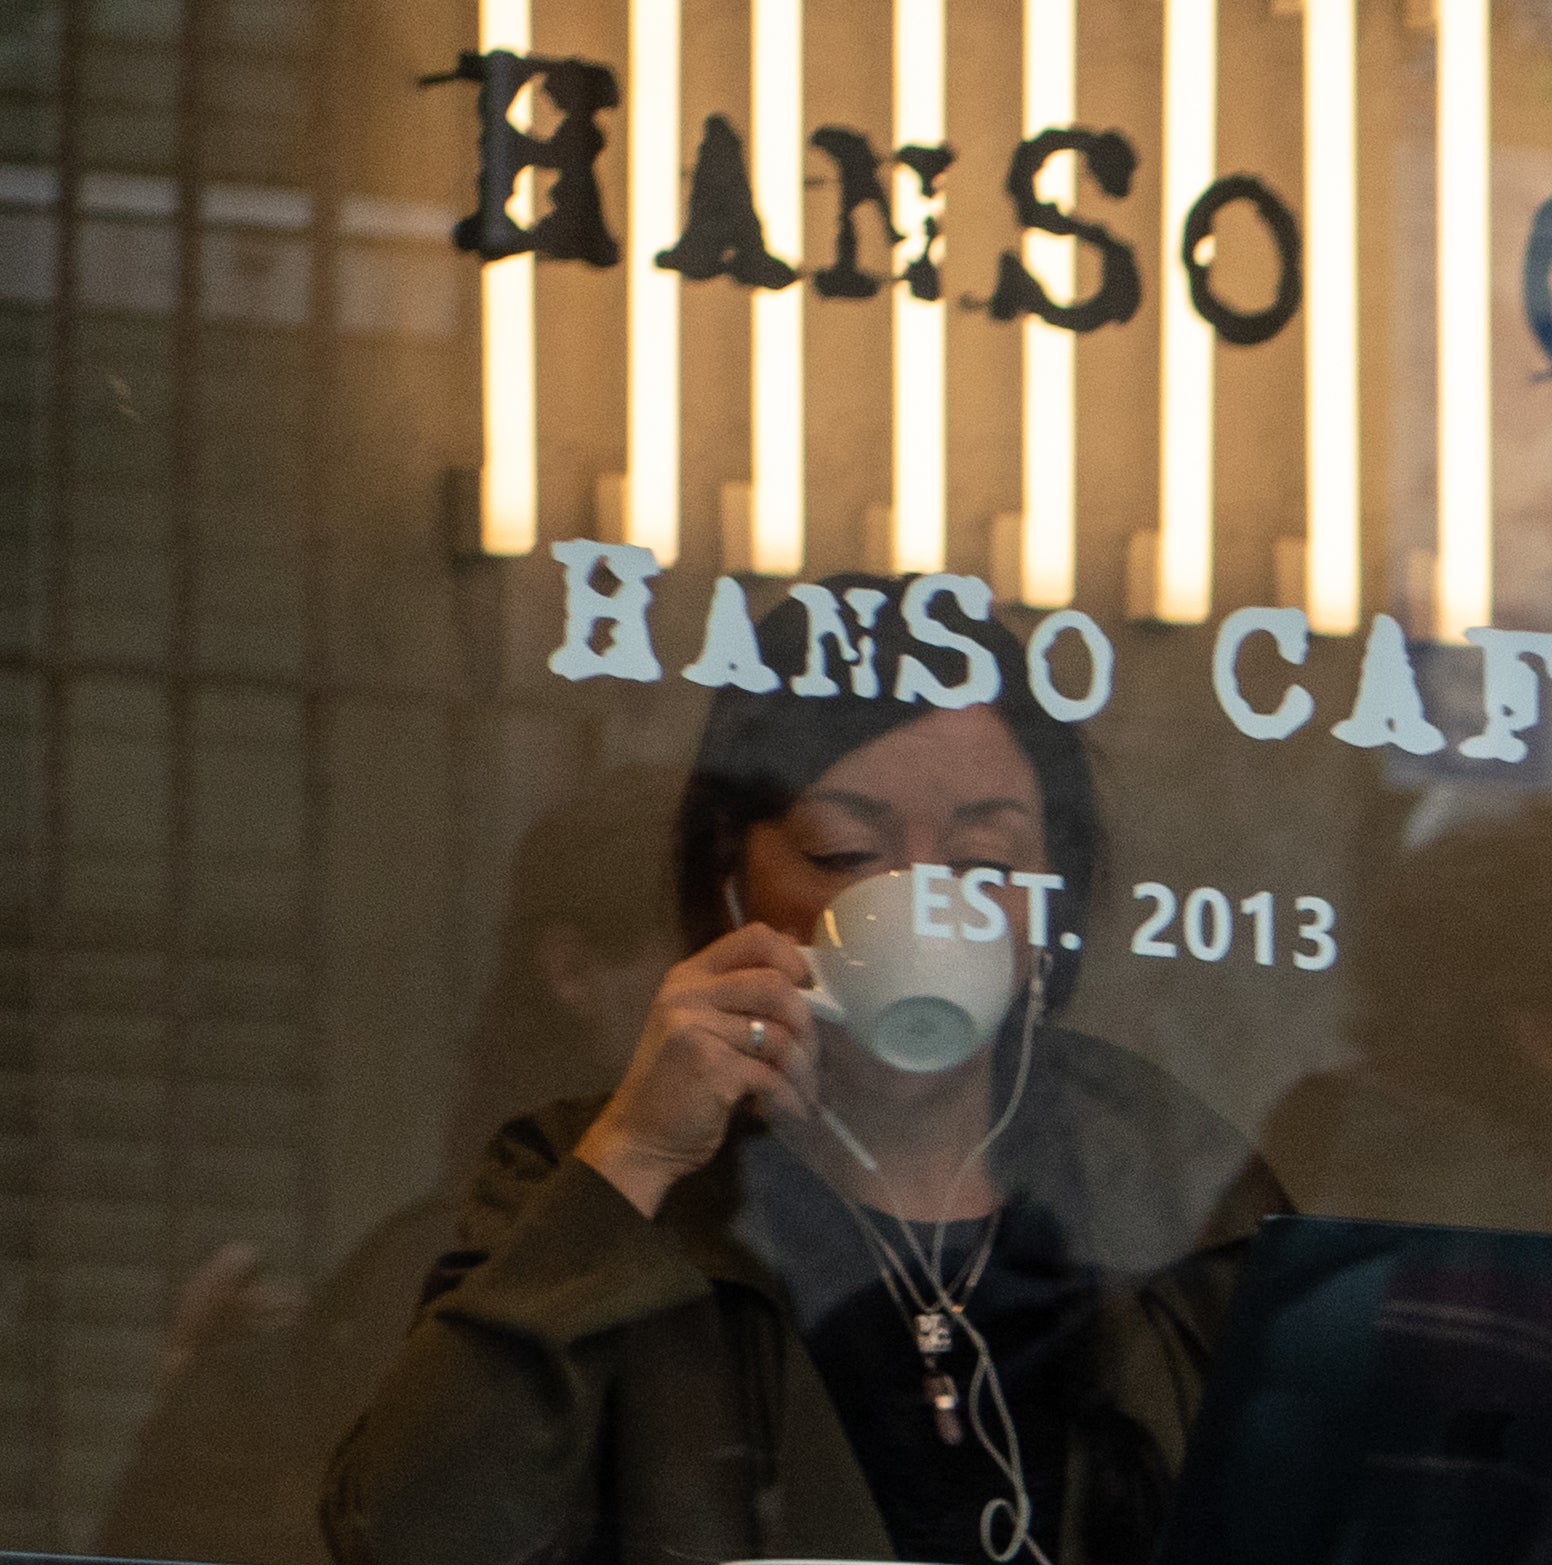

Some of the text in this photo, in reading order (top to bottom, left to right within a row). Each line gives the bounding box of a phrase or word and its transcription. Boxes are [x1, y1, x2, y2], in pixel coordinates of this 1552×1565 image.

[418, 50, 1304, 346] HANSO
[547, 536, 1114, 722] HANSO
[910, 863, 1340, 972] EST. 2013
